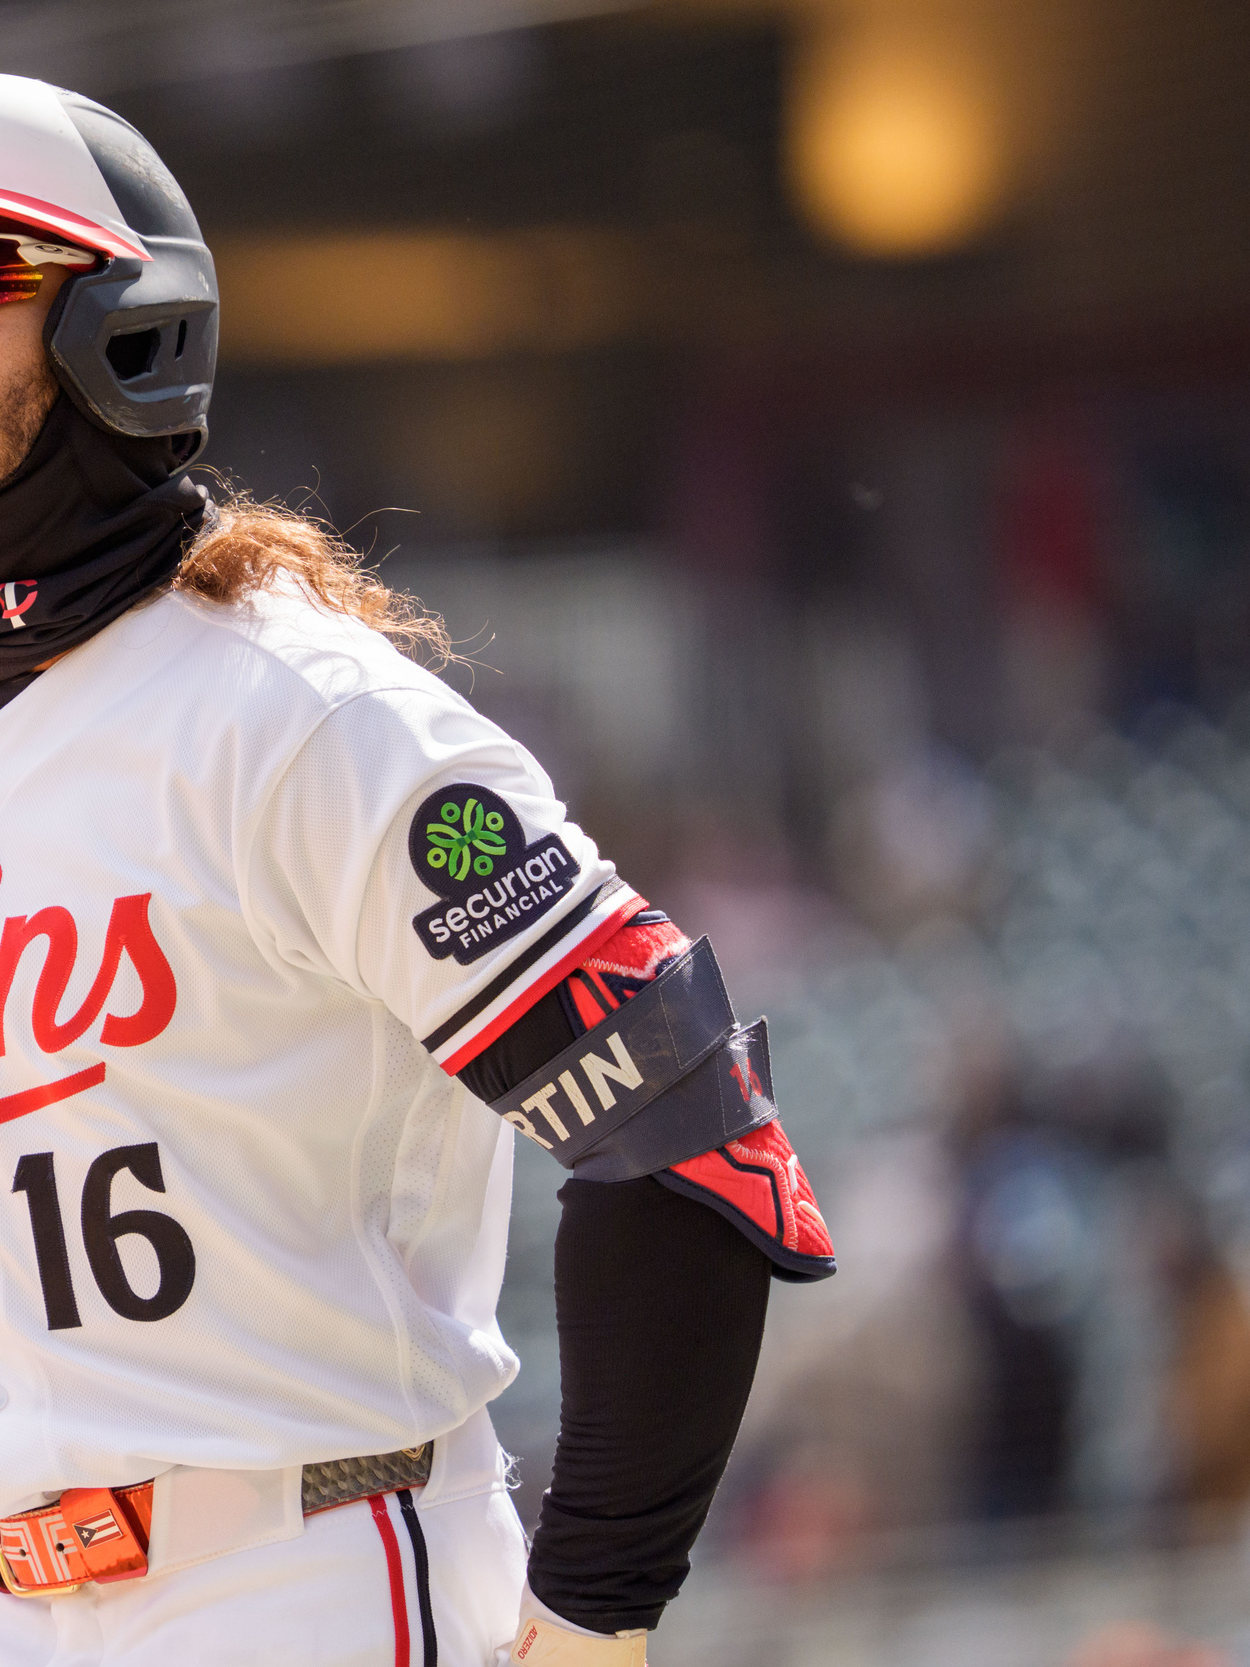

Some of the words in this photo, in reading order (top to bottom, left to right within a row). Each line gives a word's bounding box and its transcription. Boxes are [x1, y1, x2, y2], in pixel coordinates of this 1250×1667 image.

[428, 846, 567, 944] securian
[459, 879, 564, 949] FINANCIAL
[10, 1141, 196, 1331] 16
[517, 1625, 538, 1660] ADIZERO
